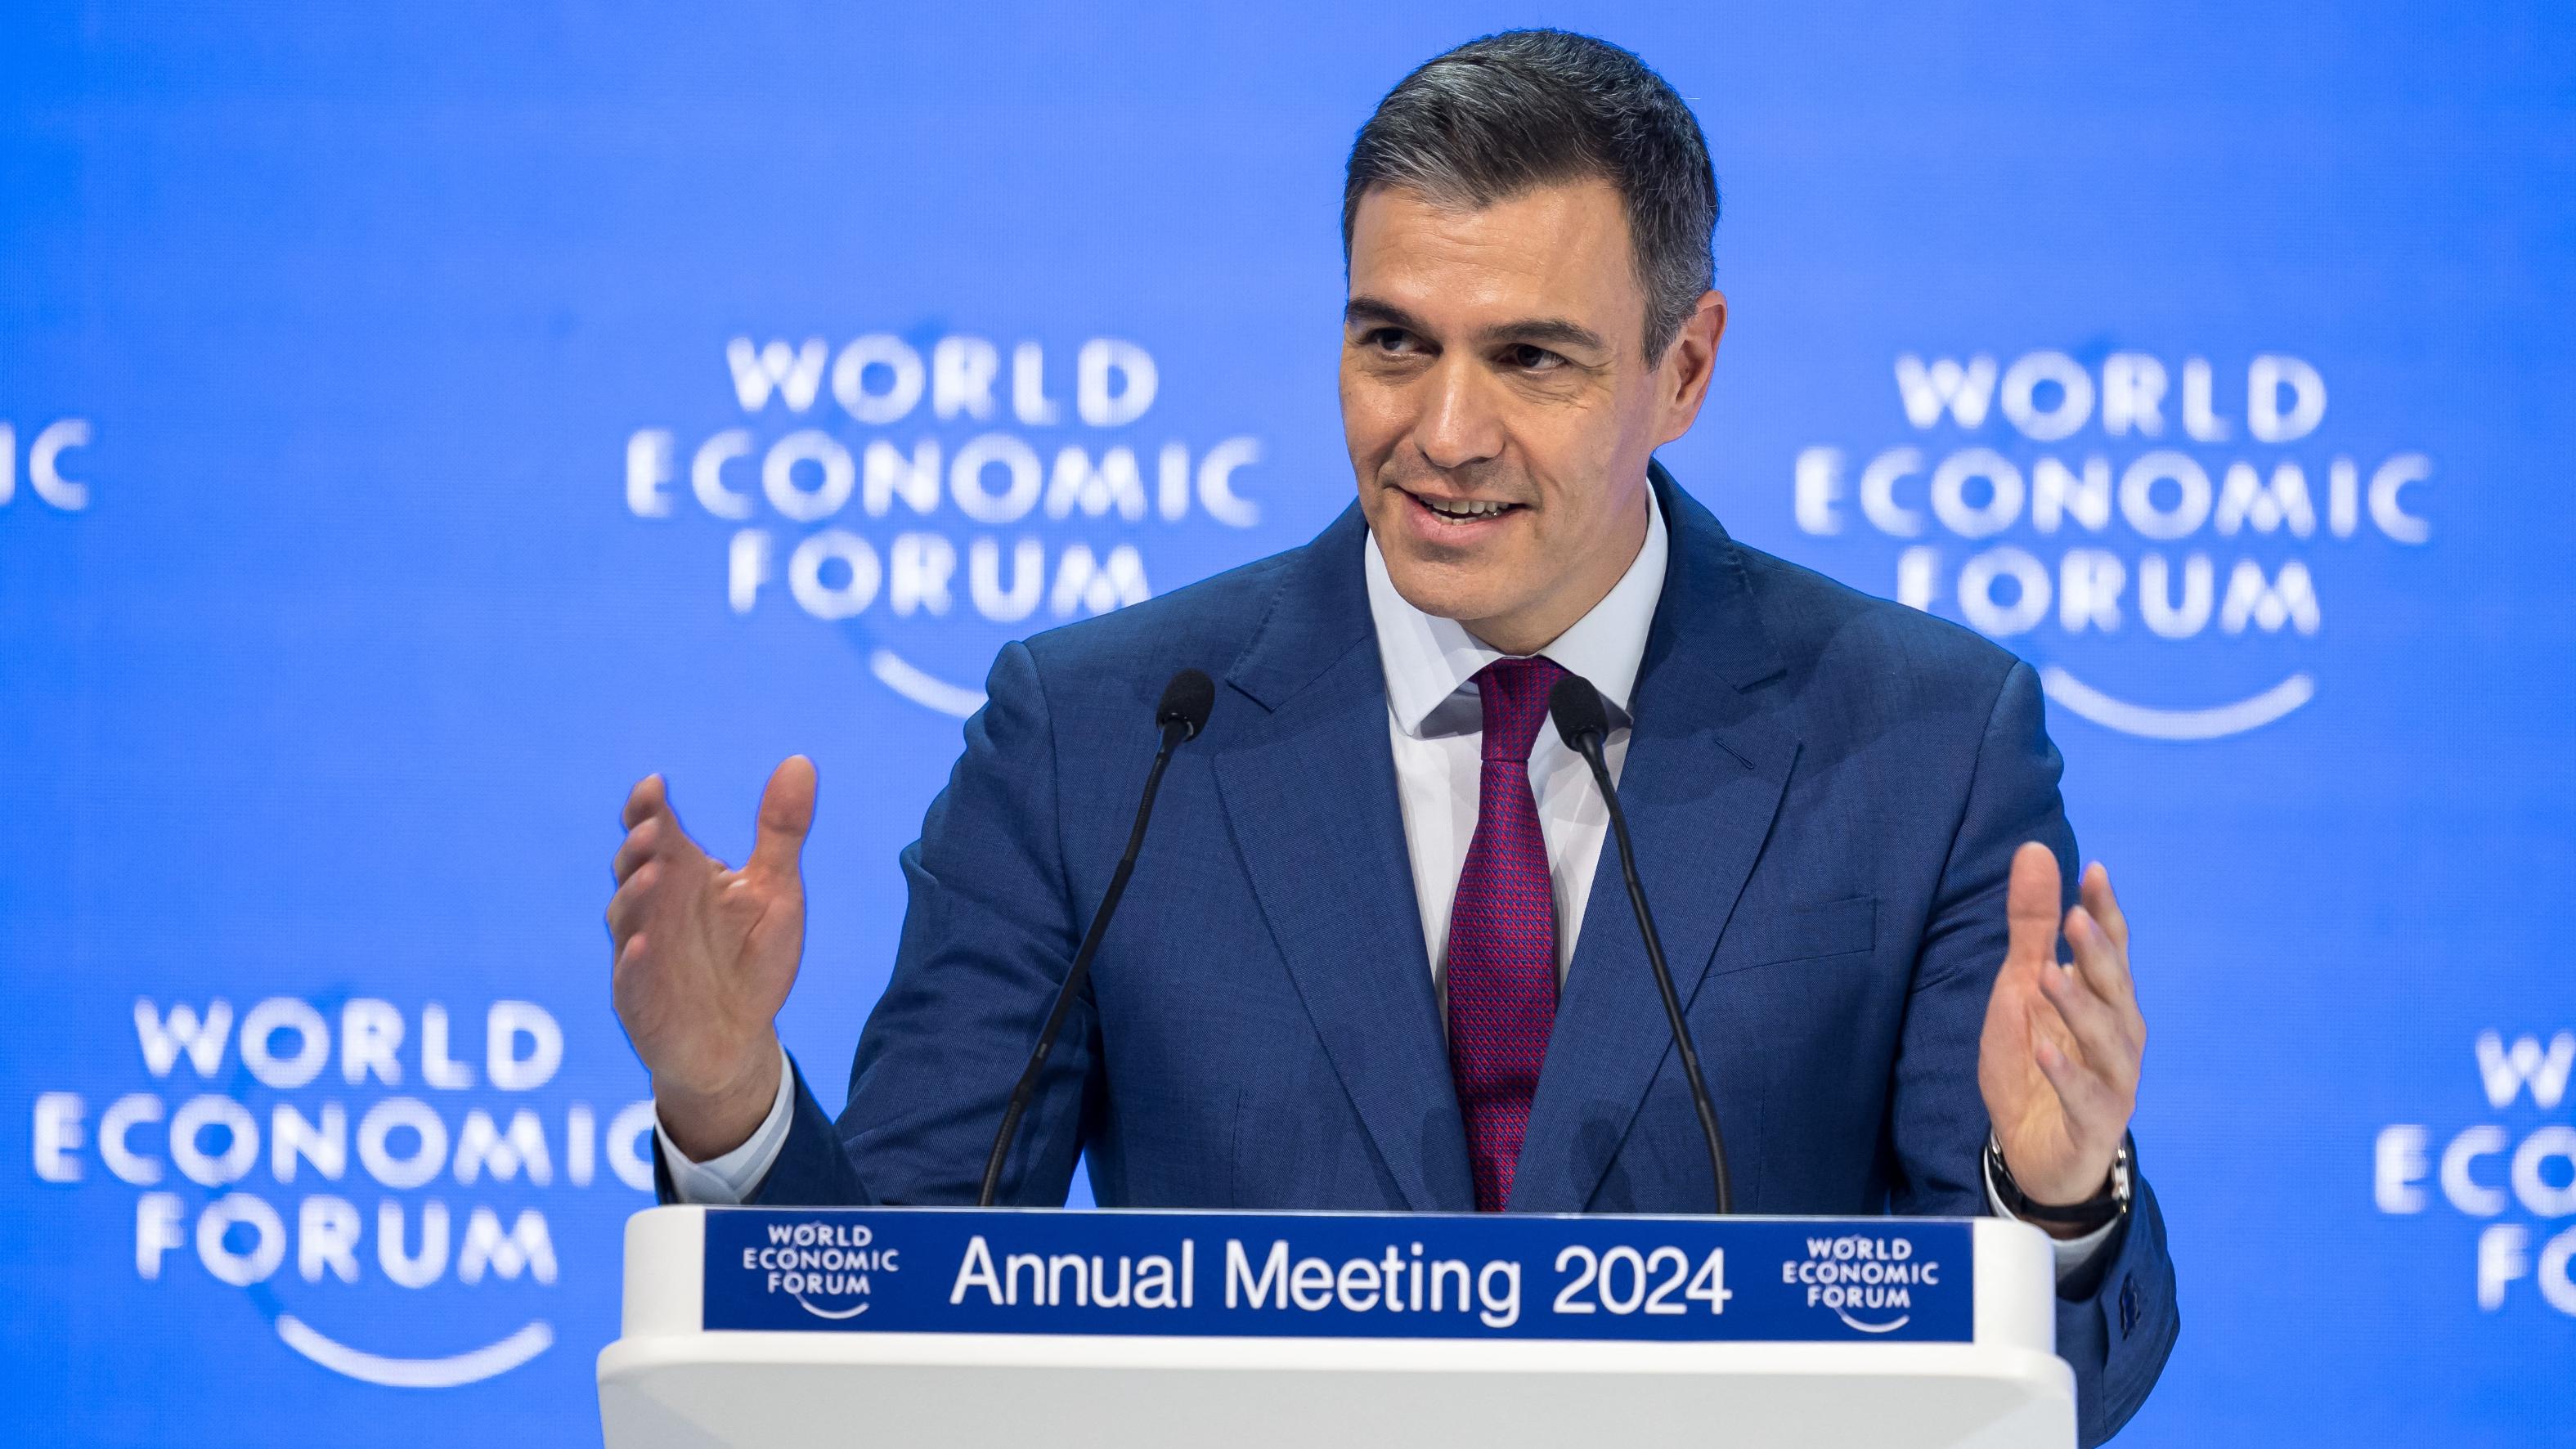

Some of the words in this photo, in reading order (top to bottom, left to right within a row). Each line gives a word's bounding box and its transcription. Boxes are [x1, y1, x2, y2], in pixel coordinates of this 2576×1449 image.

[725, 334, 1160, 428] WORLD
[1894, 350, 2327, 443] WORLD
[626, 428, 1261, 529] ECONOMIC
[1793, 444, 2430, 544] ECONOMIC
[728, 527, 1151, 622] FORUM
[1896, 545, 2322, 639] FORUM
[133, 995, 564, 1092] WORLD
[33, 1090, 655, 1192] ECONOMIC
[135, 1191, 559, 1290] FORUM
[742, 1247, 900, 1273] ECONOMIC
[768, 1223, 873, 1247] WORLD
[1782, 1260, 1939, 1286] ECONOMIC
[1806, 1236, 1912, 1262] WORLD
[767, 1271, 871, 1295] FORUM
[949, 1235, 1194, 1310] Annual
[1225, 1239, 1521, 1330] Meeting
[1553, 1245, 1733, 1316] 2024
[1806, 1285, 1911, 1309] FORUM
